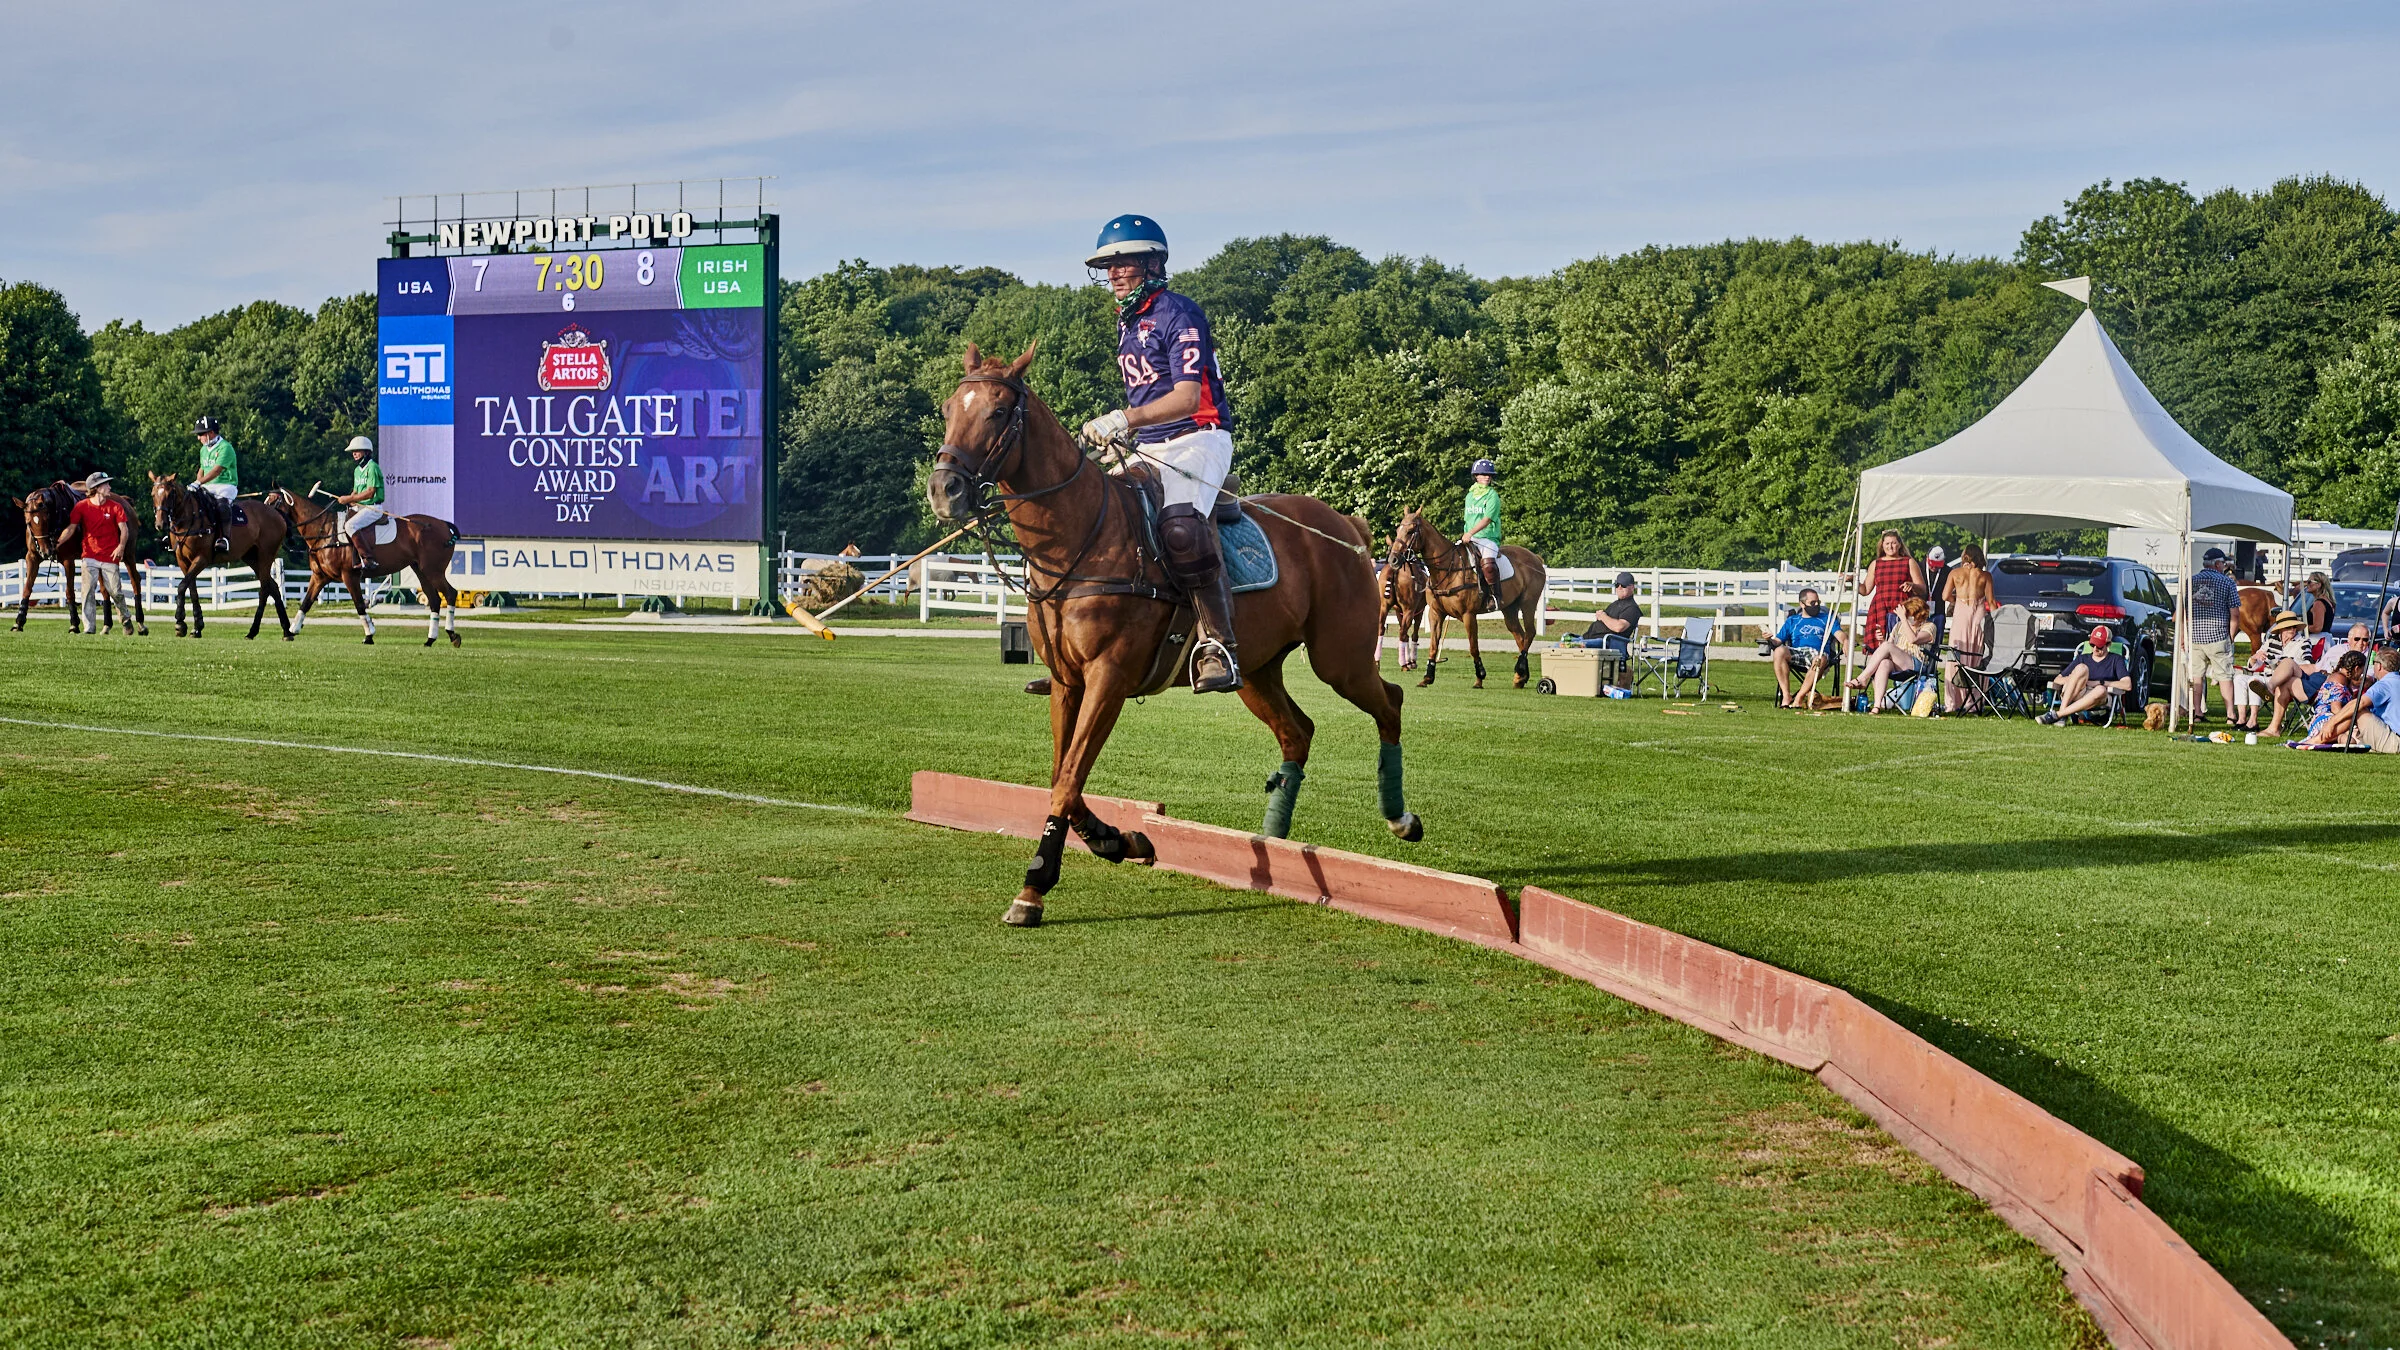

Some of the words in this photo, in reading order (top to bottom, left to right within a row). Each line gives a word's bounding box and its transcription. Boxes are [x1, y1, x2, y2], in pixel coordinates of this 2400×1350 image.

[440, 217, 597, 248] NEWPORT
[609, 212, 692, 240] POLO
[471, 258, 490, 292] 7
[533, 254, 604, 292] 7:30
[636, 251, 655, 286] 8
[697, 258, 748, 274] IRISH
[398, 280, 433, 294] USA
[704, 280, 741, 294] USA
[561, 293, 575, 312] 6
[552, 352, 598, 367] STELLA
[1182, 347, 1200, 374] 2
[552, 367, 599, 381] ARTOIS
[474, 395, 679, 437] TAILGATE
[508, 437, 643, 467] CONTEST
[533, 469, 616, 493] AWARD
[560, 494, 571, 503] OF
[574, 494, 589, 502] THE
[556, 504, 594, 523] DAY
[633, 579, 734, 593] INSURANCE
[2029, 600, 2048, 609] Jeep
